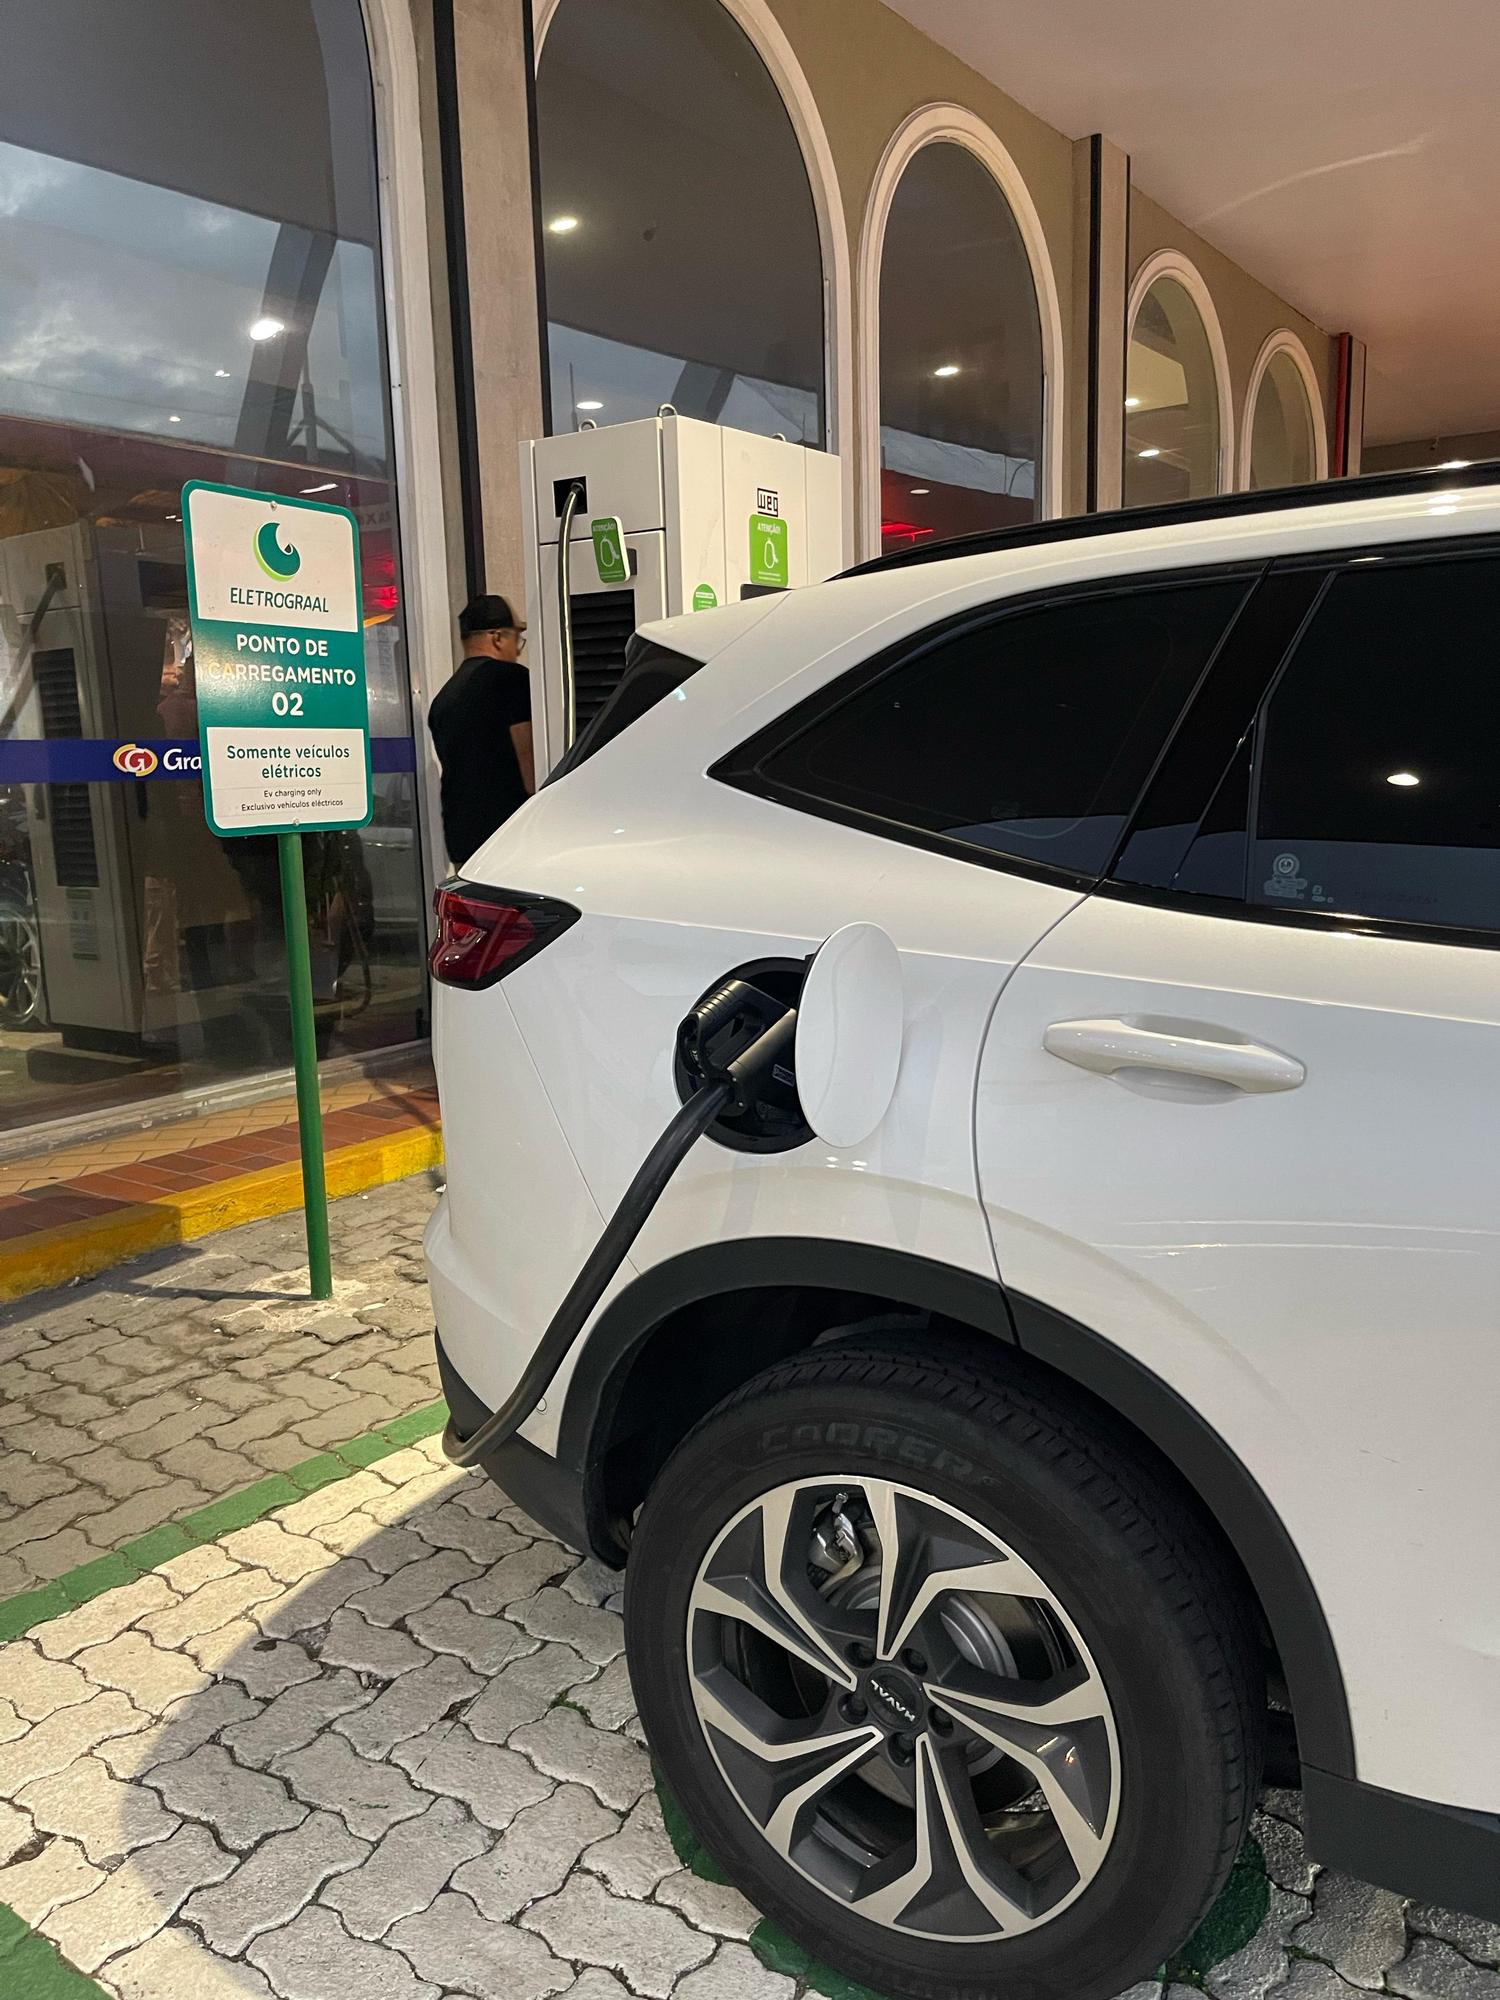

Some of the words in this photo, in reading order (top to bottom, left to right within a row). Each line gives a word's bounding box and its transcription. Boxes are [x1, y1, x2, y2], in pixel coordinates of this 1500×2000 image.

[230, 587, 329, 613] ELETROGRAAL
[236, 633, 300, 655] PONTO
[305, 639, 328, 657] DE
[208, 661, 356, 686] CARREGAMENTO
[271, 691, 304, 717] 02
[227, 745, 291, 759] Somente
[295, 744, 350, 758] veículos
[261, 764, 322, 778] elétricos
[274, 788, 306, 798] charging
[307, 788, 322, 796] only
[241, 803, 276, 811] Exclusivo
[870, 1679, 916, 1722] HAVAL
